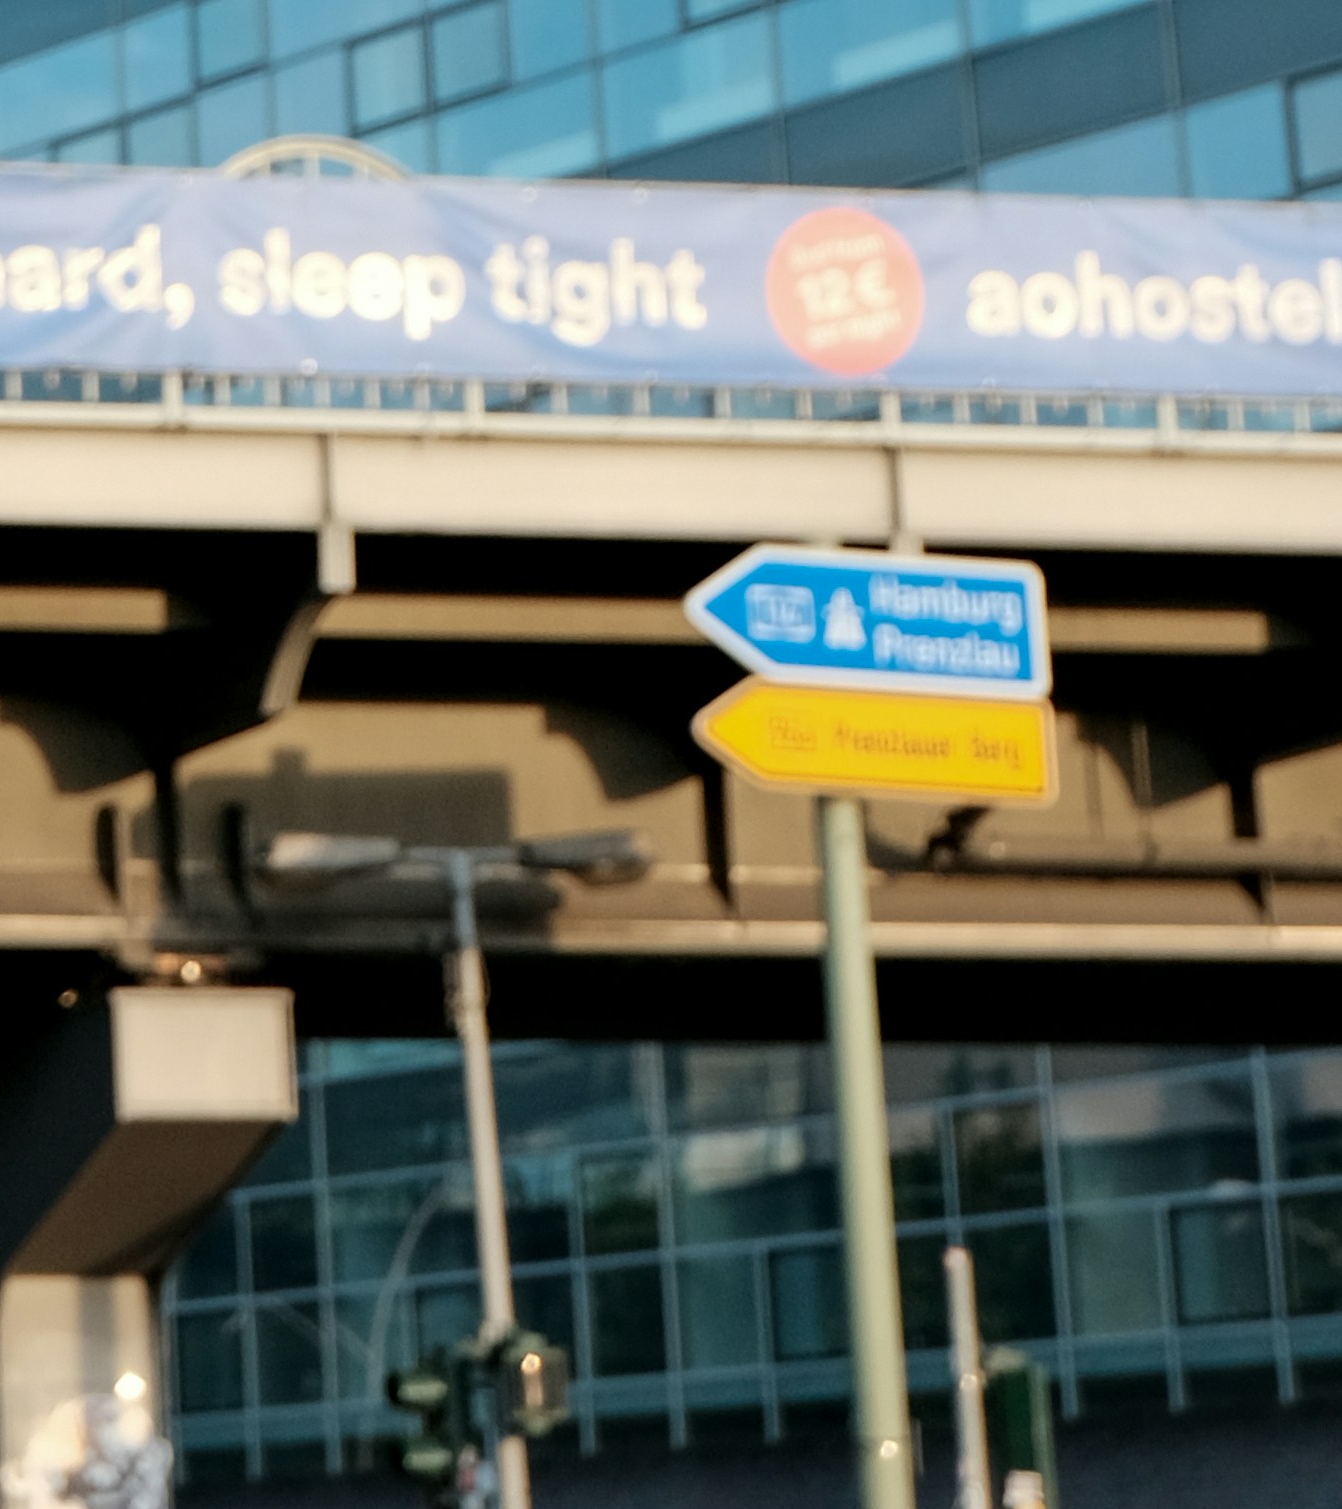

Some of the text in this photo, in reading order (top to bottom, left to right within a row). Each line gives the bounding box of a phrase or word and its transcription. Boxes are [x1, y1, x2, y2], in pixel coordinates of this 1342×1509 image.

[220, 227, 467, 341] sleep
[485, 234, 708, 348] tight
[868, 572, 1023, 637] Hamburg
[872, 622, 1021, 677] Prenzlau
